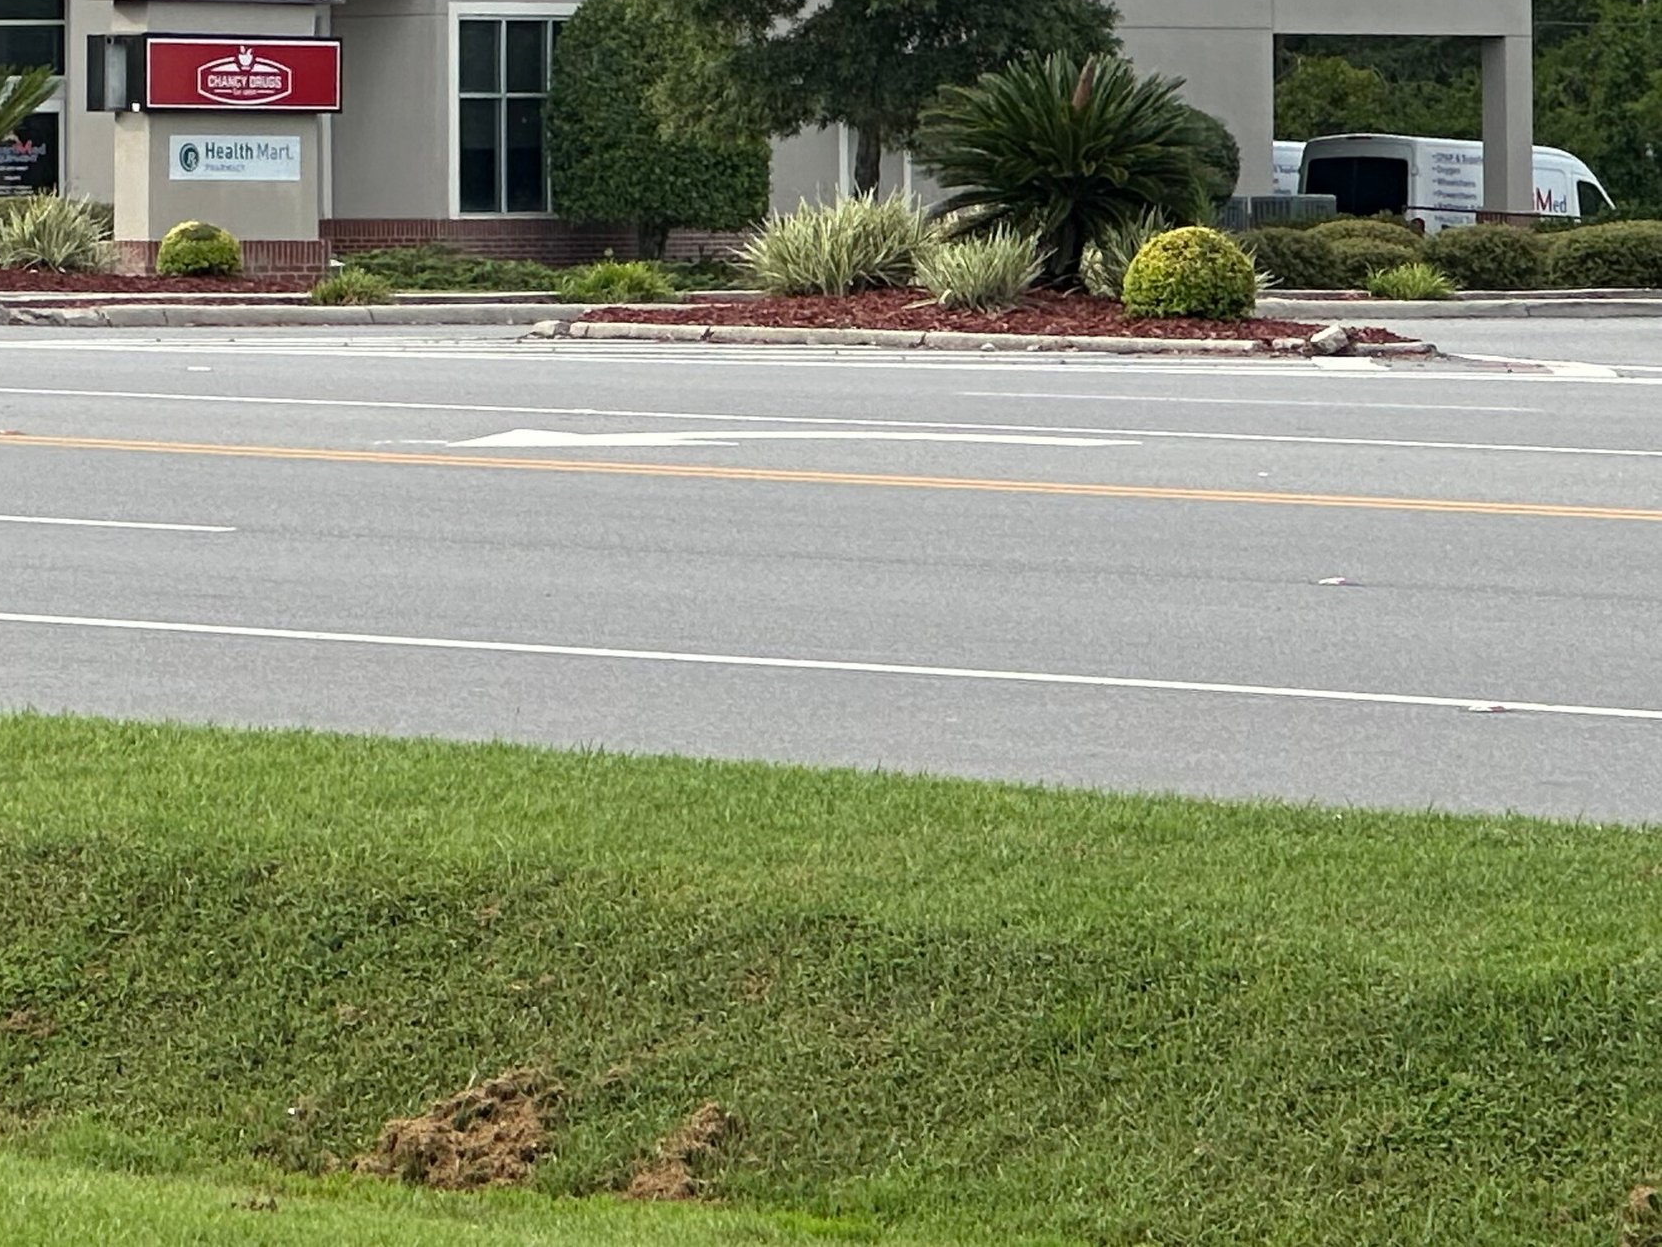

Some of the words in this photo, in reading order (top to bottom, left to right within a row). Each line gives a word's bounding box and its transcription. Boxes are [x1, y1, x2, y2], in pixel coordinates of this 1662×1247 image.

[207, 74, 249, 88] CHANCY
[248, 75, 283, 89] DRUGS
[205, 141, 254, 160] Health
[1533, 186, 1567, 214] Med
